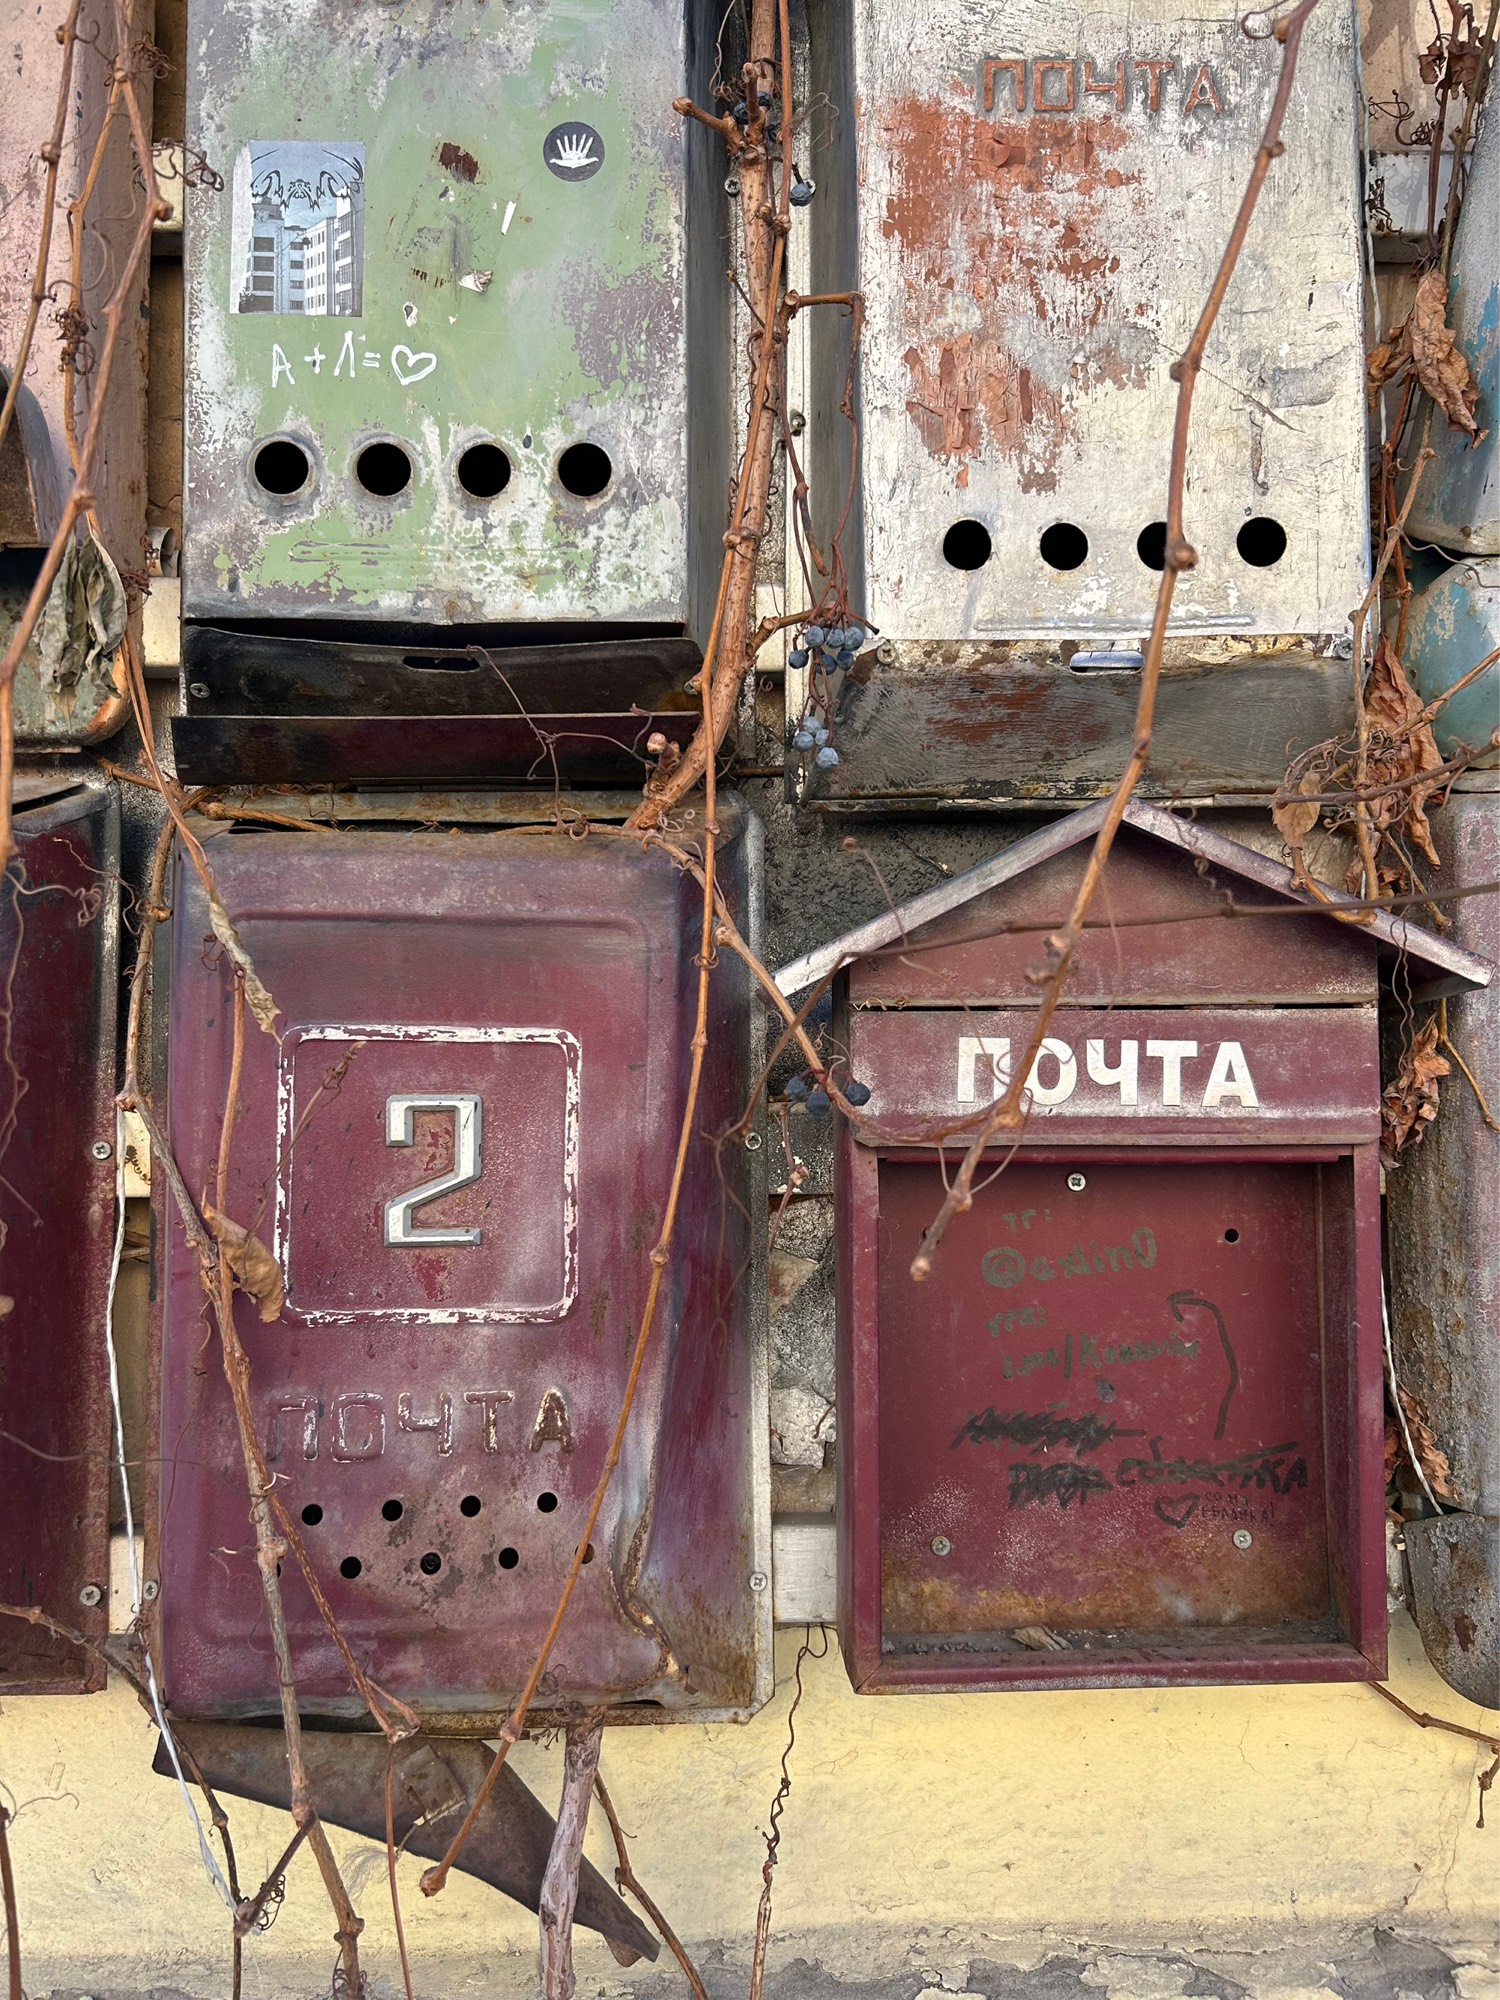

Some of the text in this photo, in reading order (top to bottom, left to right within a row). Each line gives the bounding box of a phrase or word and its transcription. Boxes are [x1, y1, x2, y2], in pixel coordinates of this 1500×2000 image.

[983, 60, 1222, 114] ПОЧТА
[956, 1036, 1260, 1109] ПОЧТА
[384, 1094, 483, 1248] 2
[265, 1387, 575, 1463] ПОЧТА
